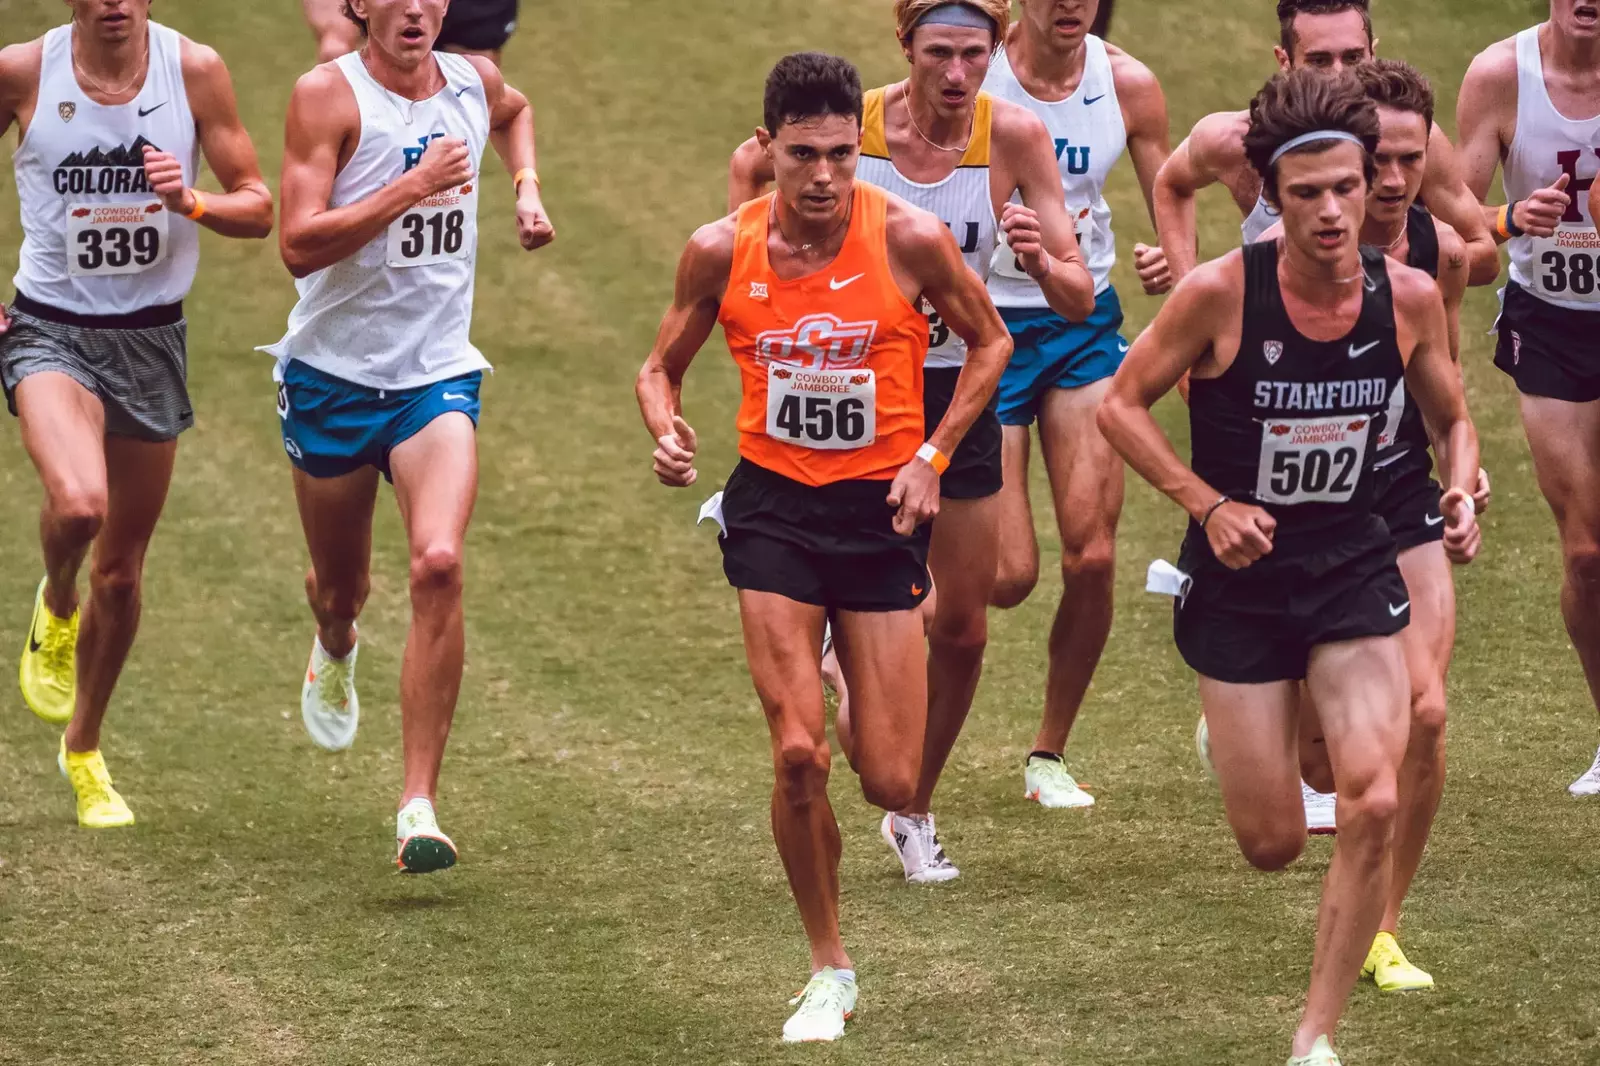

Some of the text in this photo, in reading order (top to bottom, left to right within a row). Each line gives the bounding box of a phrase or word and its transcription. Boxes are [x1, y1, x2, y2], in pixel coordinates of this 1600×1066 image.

[53, 167, 154, 195] COLORA
[90, 215, 145, 224] JAMBOREE
[94, 207, 141, 216] COWBOY
[77, 226, 160, 270] 339
[401, 209, 464, 259] 318
[1558, 231, 1597, 240] COWBO
[1541, 251, 1600, 295] 38
[756, 312, 878, 371] OSU
[791, 382, 850, 393] JAMBOREE
[795, 372, 845, 384] COWBOY
[1254, 378, 1386, 410] STANFORD
[776, 394, 865, 442] 456
[1294, 422, 1344, 434] COWBOY
[1289, 432, 1347, 445] JAMBOREE
[1270, 447, 1358, 496] 502
